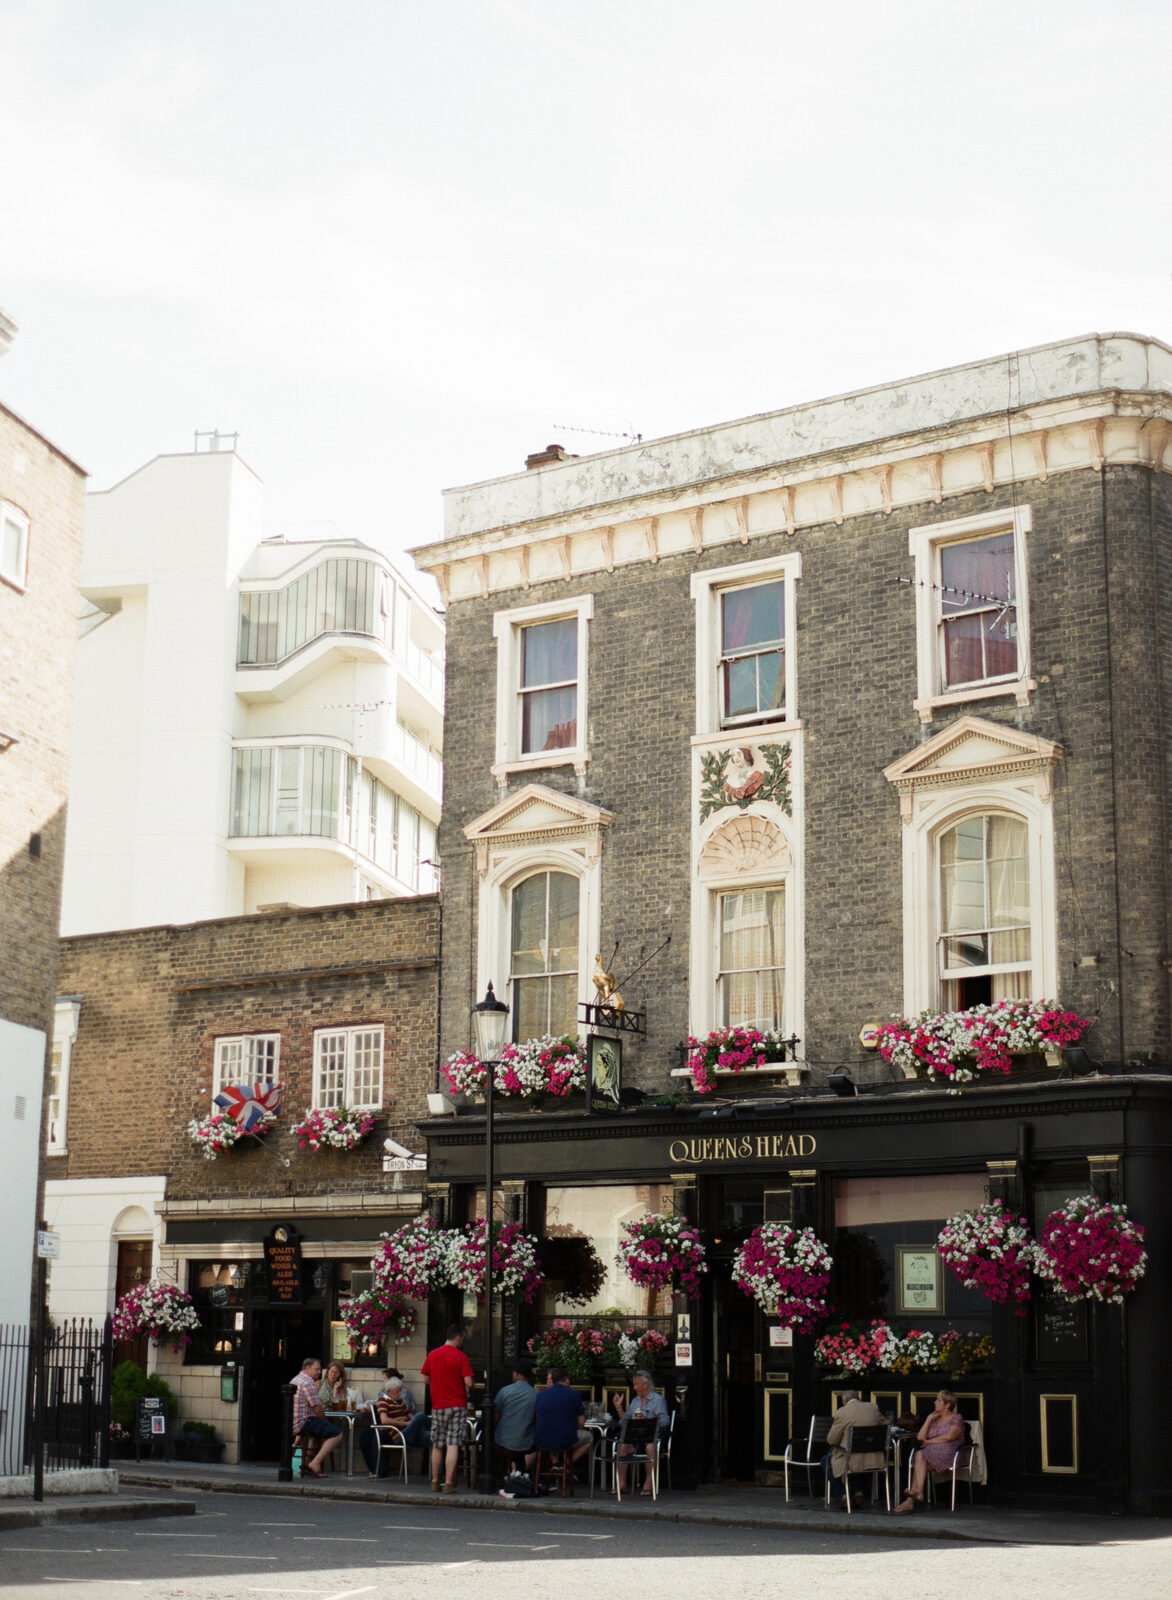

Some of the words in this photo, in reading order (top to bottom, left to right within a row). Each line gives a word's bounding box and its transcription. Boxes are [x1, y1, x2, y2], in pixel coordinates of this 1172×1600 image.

[669, 1134, 752, 1163] QUEENS
[755, 1134, 817, 1158] HEAD
[269, 1247, 296, 1255] QUALITY
